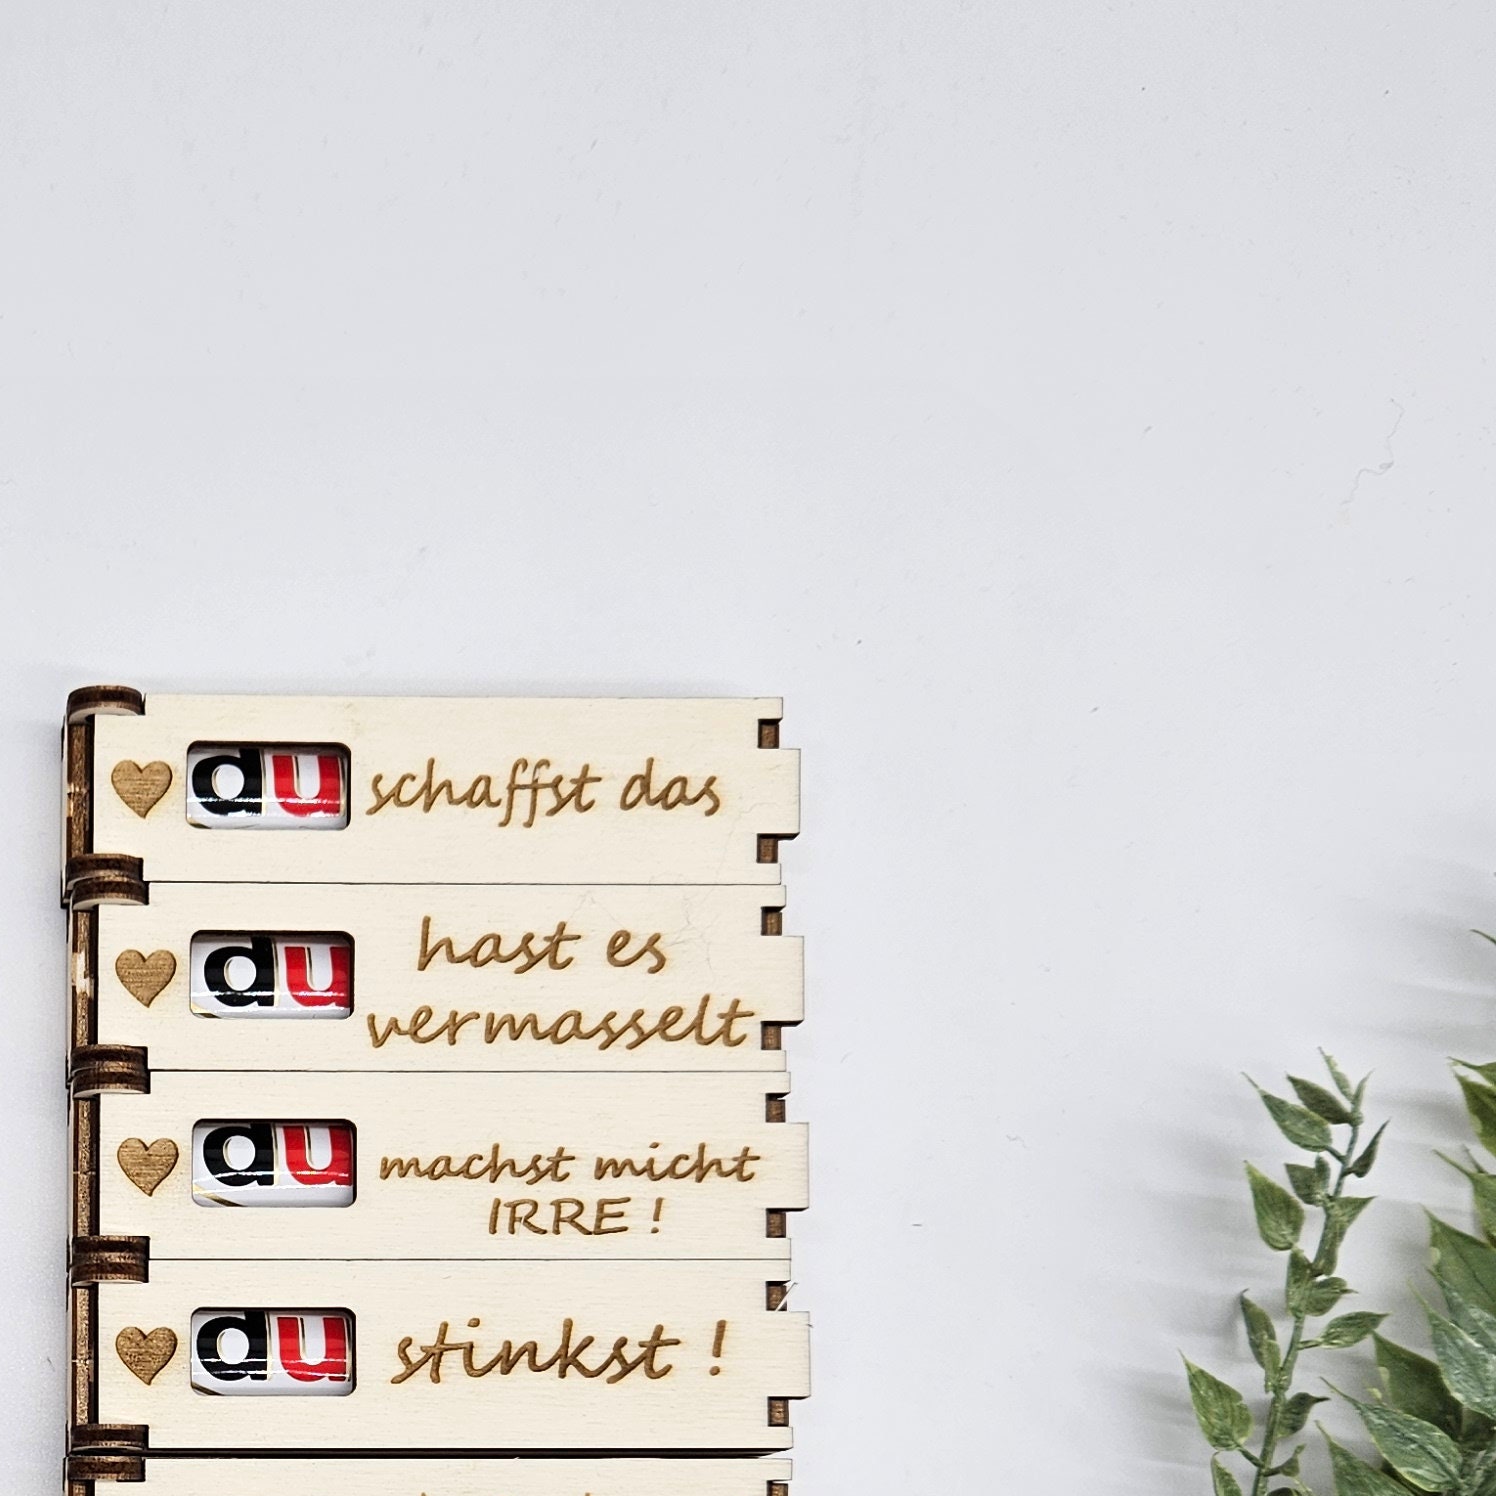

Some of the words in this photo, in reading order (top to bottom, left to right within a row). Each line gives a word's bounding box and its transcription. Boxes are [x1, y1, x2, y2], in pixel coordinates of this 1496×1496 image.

[191, 749, 345, 817] du
[365, 757, 604, 829] schaffst
[619, 756, 721, 817] das
[202, 937, 351, 1008] du
[416, 915, 583, 975] hast
[606, 929, 668, 975] es
[366, 993, 757, 1051] vermasselt
[379, 1142, 577, 1186] machst
[593, 1141, 762, 1184] micht
[488, 1196, 632, 1236] IRRE
[650, 1196, 665, 1235] !
[195, 1311, 352, 1382] du
[389, 1317, 683, 1385] stinkst
[708, 1319, 728, 1377] !
